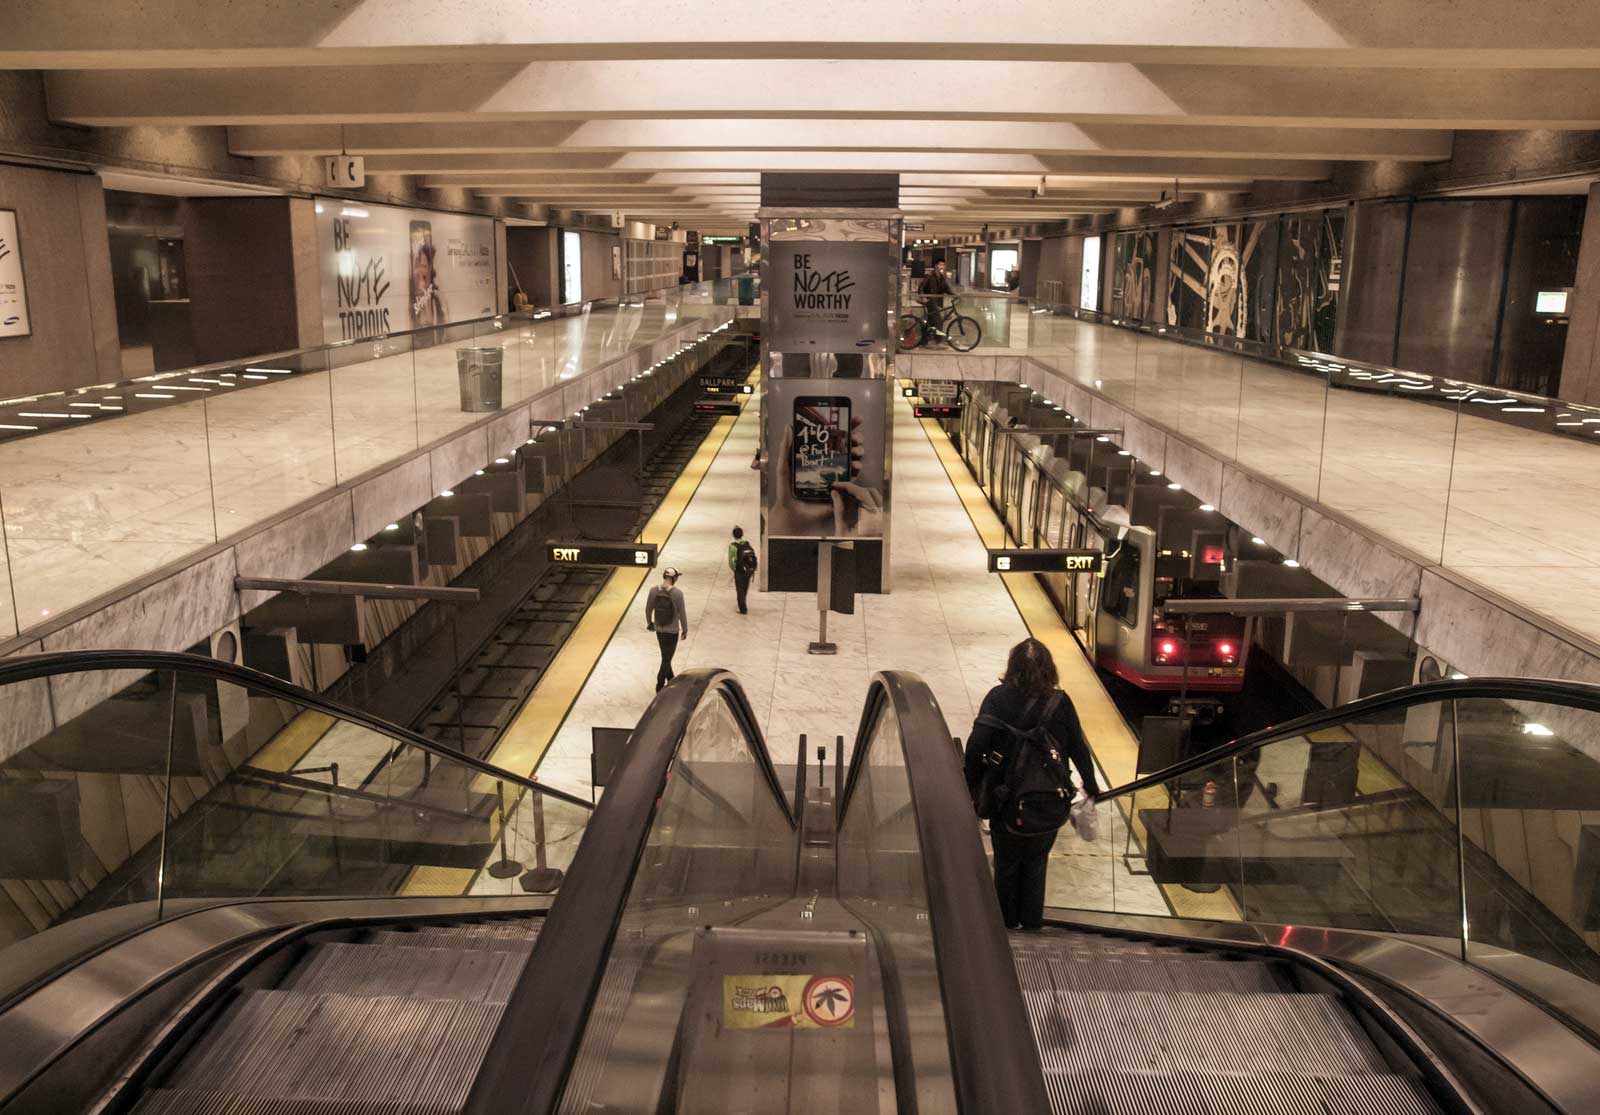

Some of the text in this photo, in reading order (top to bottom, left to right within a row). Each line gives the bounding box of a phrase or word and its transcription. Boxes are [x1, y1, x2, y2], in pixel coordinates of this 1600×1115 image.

[333, 218, 350, 252] BE
[794, 254, 811, 269] BE
[337, 256, 390, 308] NOTE
[794, 270, 856, 293] NOTE
[794, 294, 851, 309] WORTHY
[816, 424, 829, 443] 6
[553, 548, 580, 561] EXIT
[1066, 556, 1094, 569] EXIT
